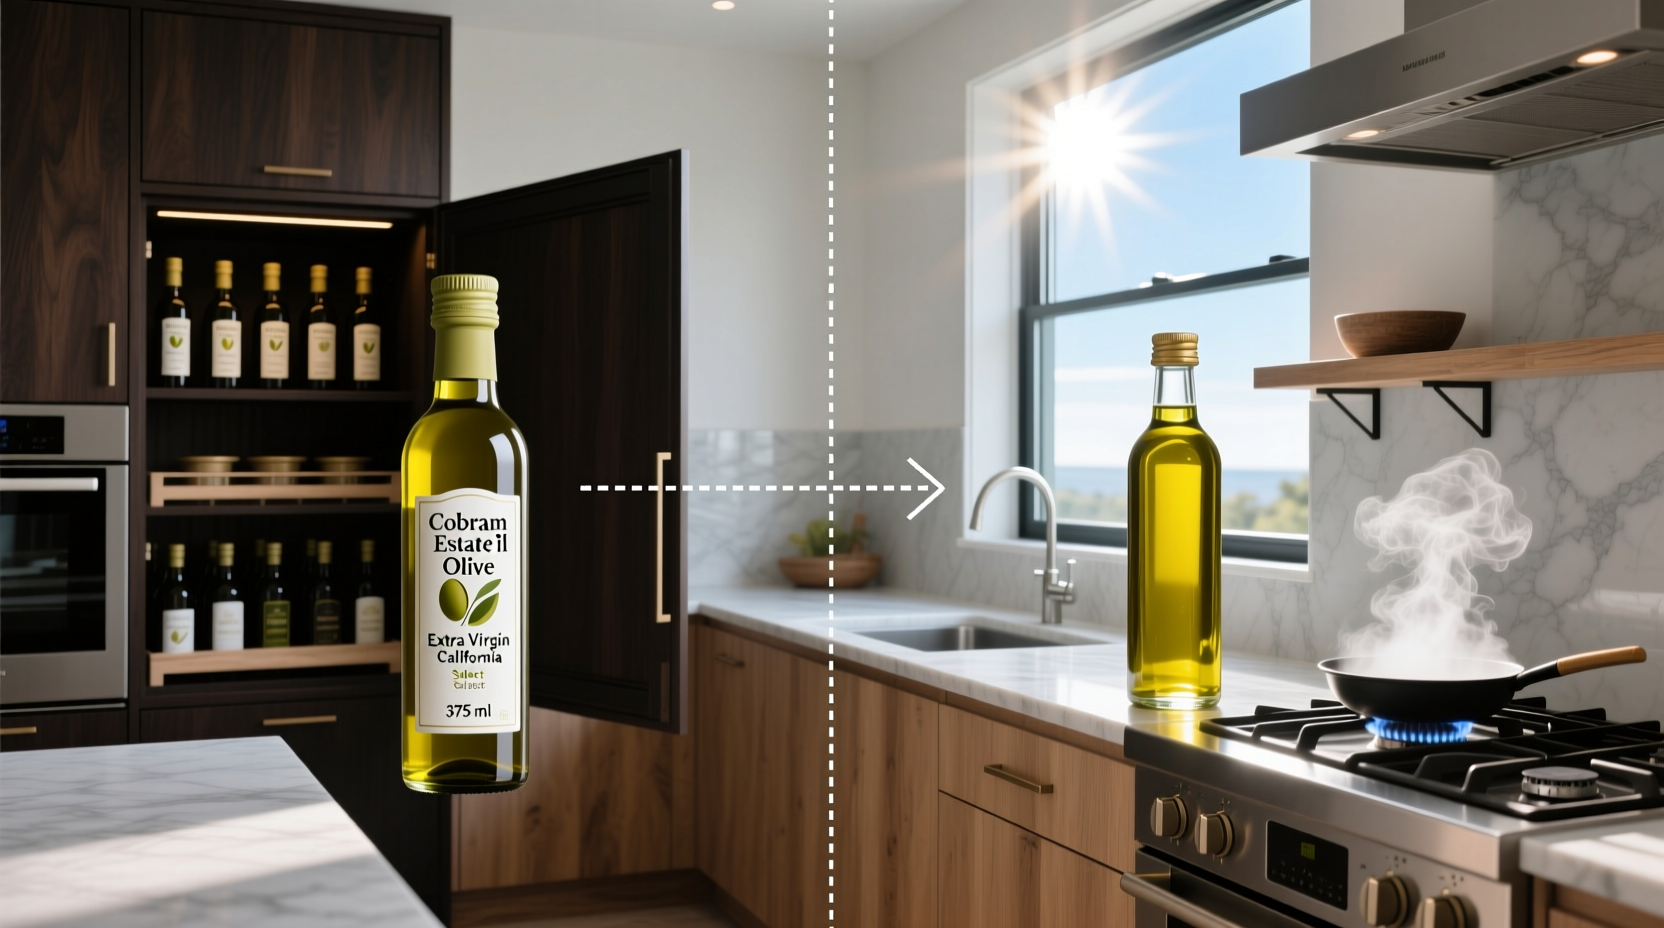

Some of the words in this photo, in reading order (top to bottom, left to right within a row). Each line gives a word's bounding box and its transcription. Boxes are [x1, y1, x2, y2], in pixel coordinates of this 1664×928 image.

[429, 512, 507, 531] Cobram
[433, 535, 493, 553] Estate
[443, 556, 495, 576] Olive
[427, 633, 465, 647] Extra
[468, 632, 510, 651] Virgin
[445, 703, 471, 718] 375
[474, 703, 491, 717] ml
